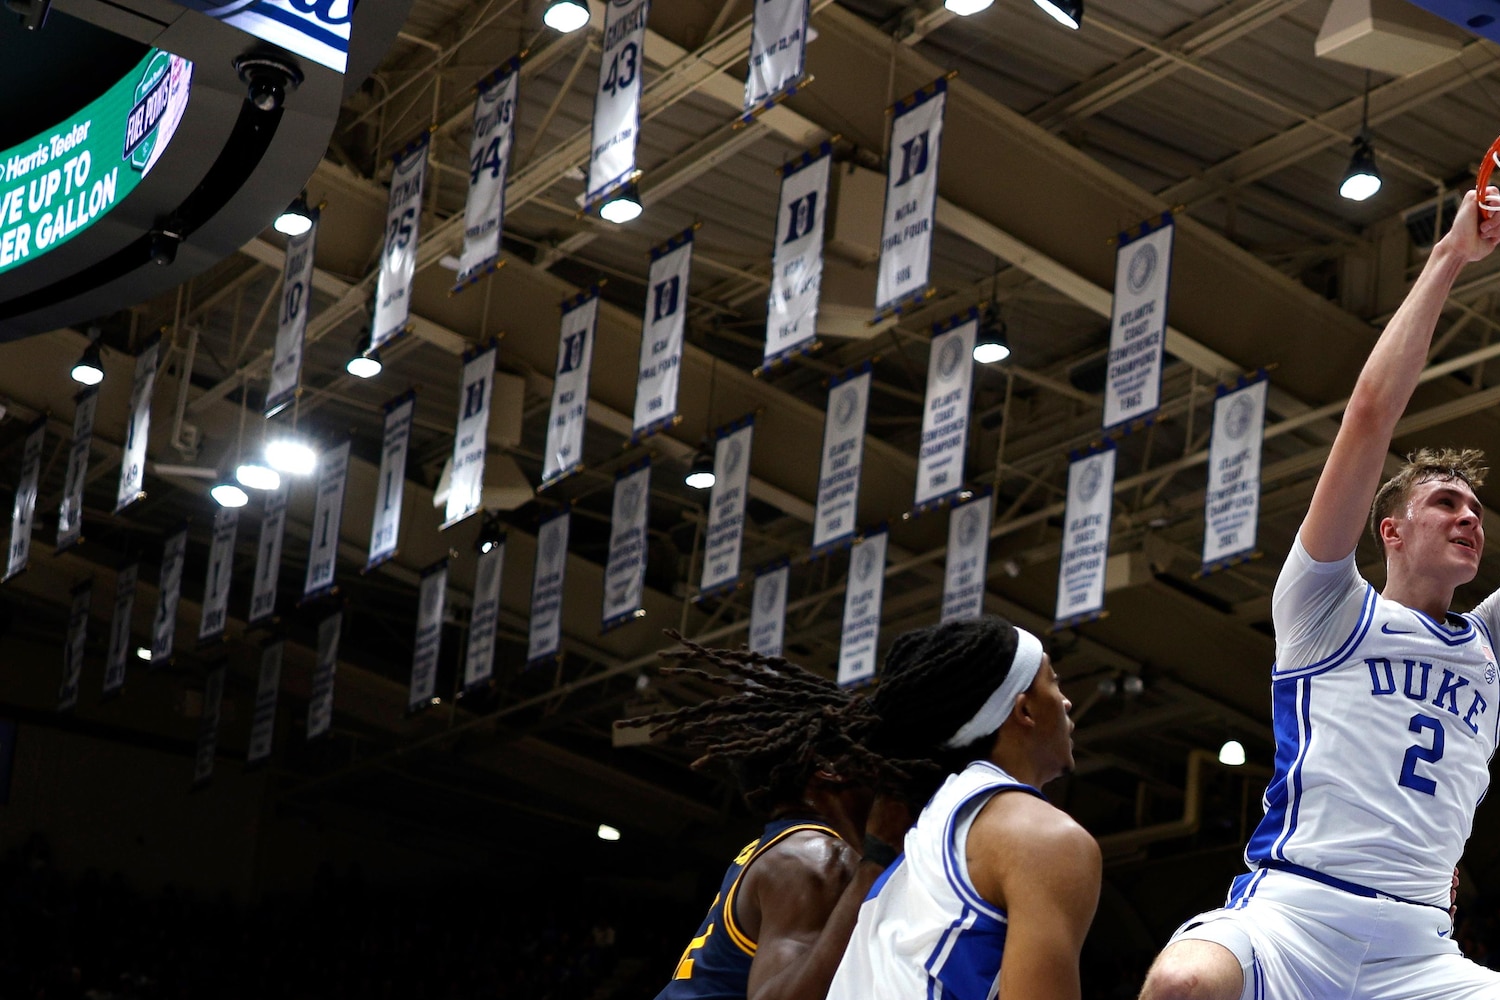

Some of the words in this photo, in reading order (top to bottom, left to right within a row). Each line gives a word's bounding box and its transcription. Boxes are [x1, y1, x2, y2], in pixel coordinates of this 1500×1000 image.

[602, 42, 638, 97] 43
[6, 144, 48, 182] Harris
[50, 120, 91, 160] Teeter
[28, 169, 61, 213] UP
[64, 150, 91, 195] TO
[470, 136, 503, 185] 44
[0, 223, 31, 268] ER
[35, 167, 118, 250] GALLON
[1364, 657, 1488, 735] DUKE
[1397, 713, 1446, 797] 2
